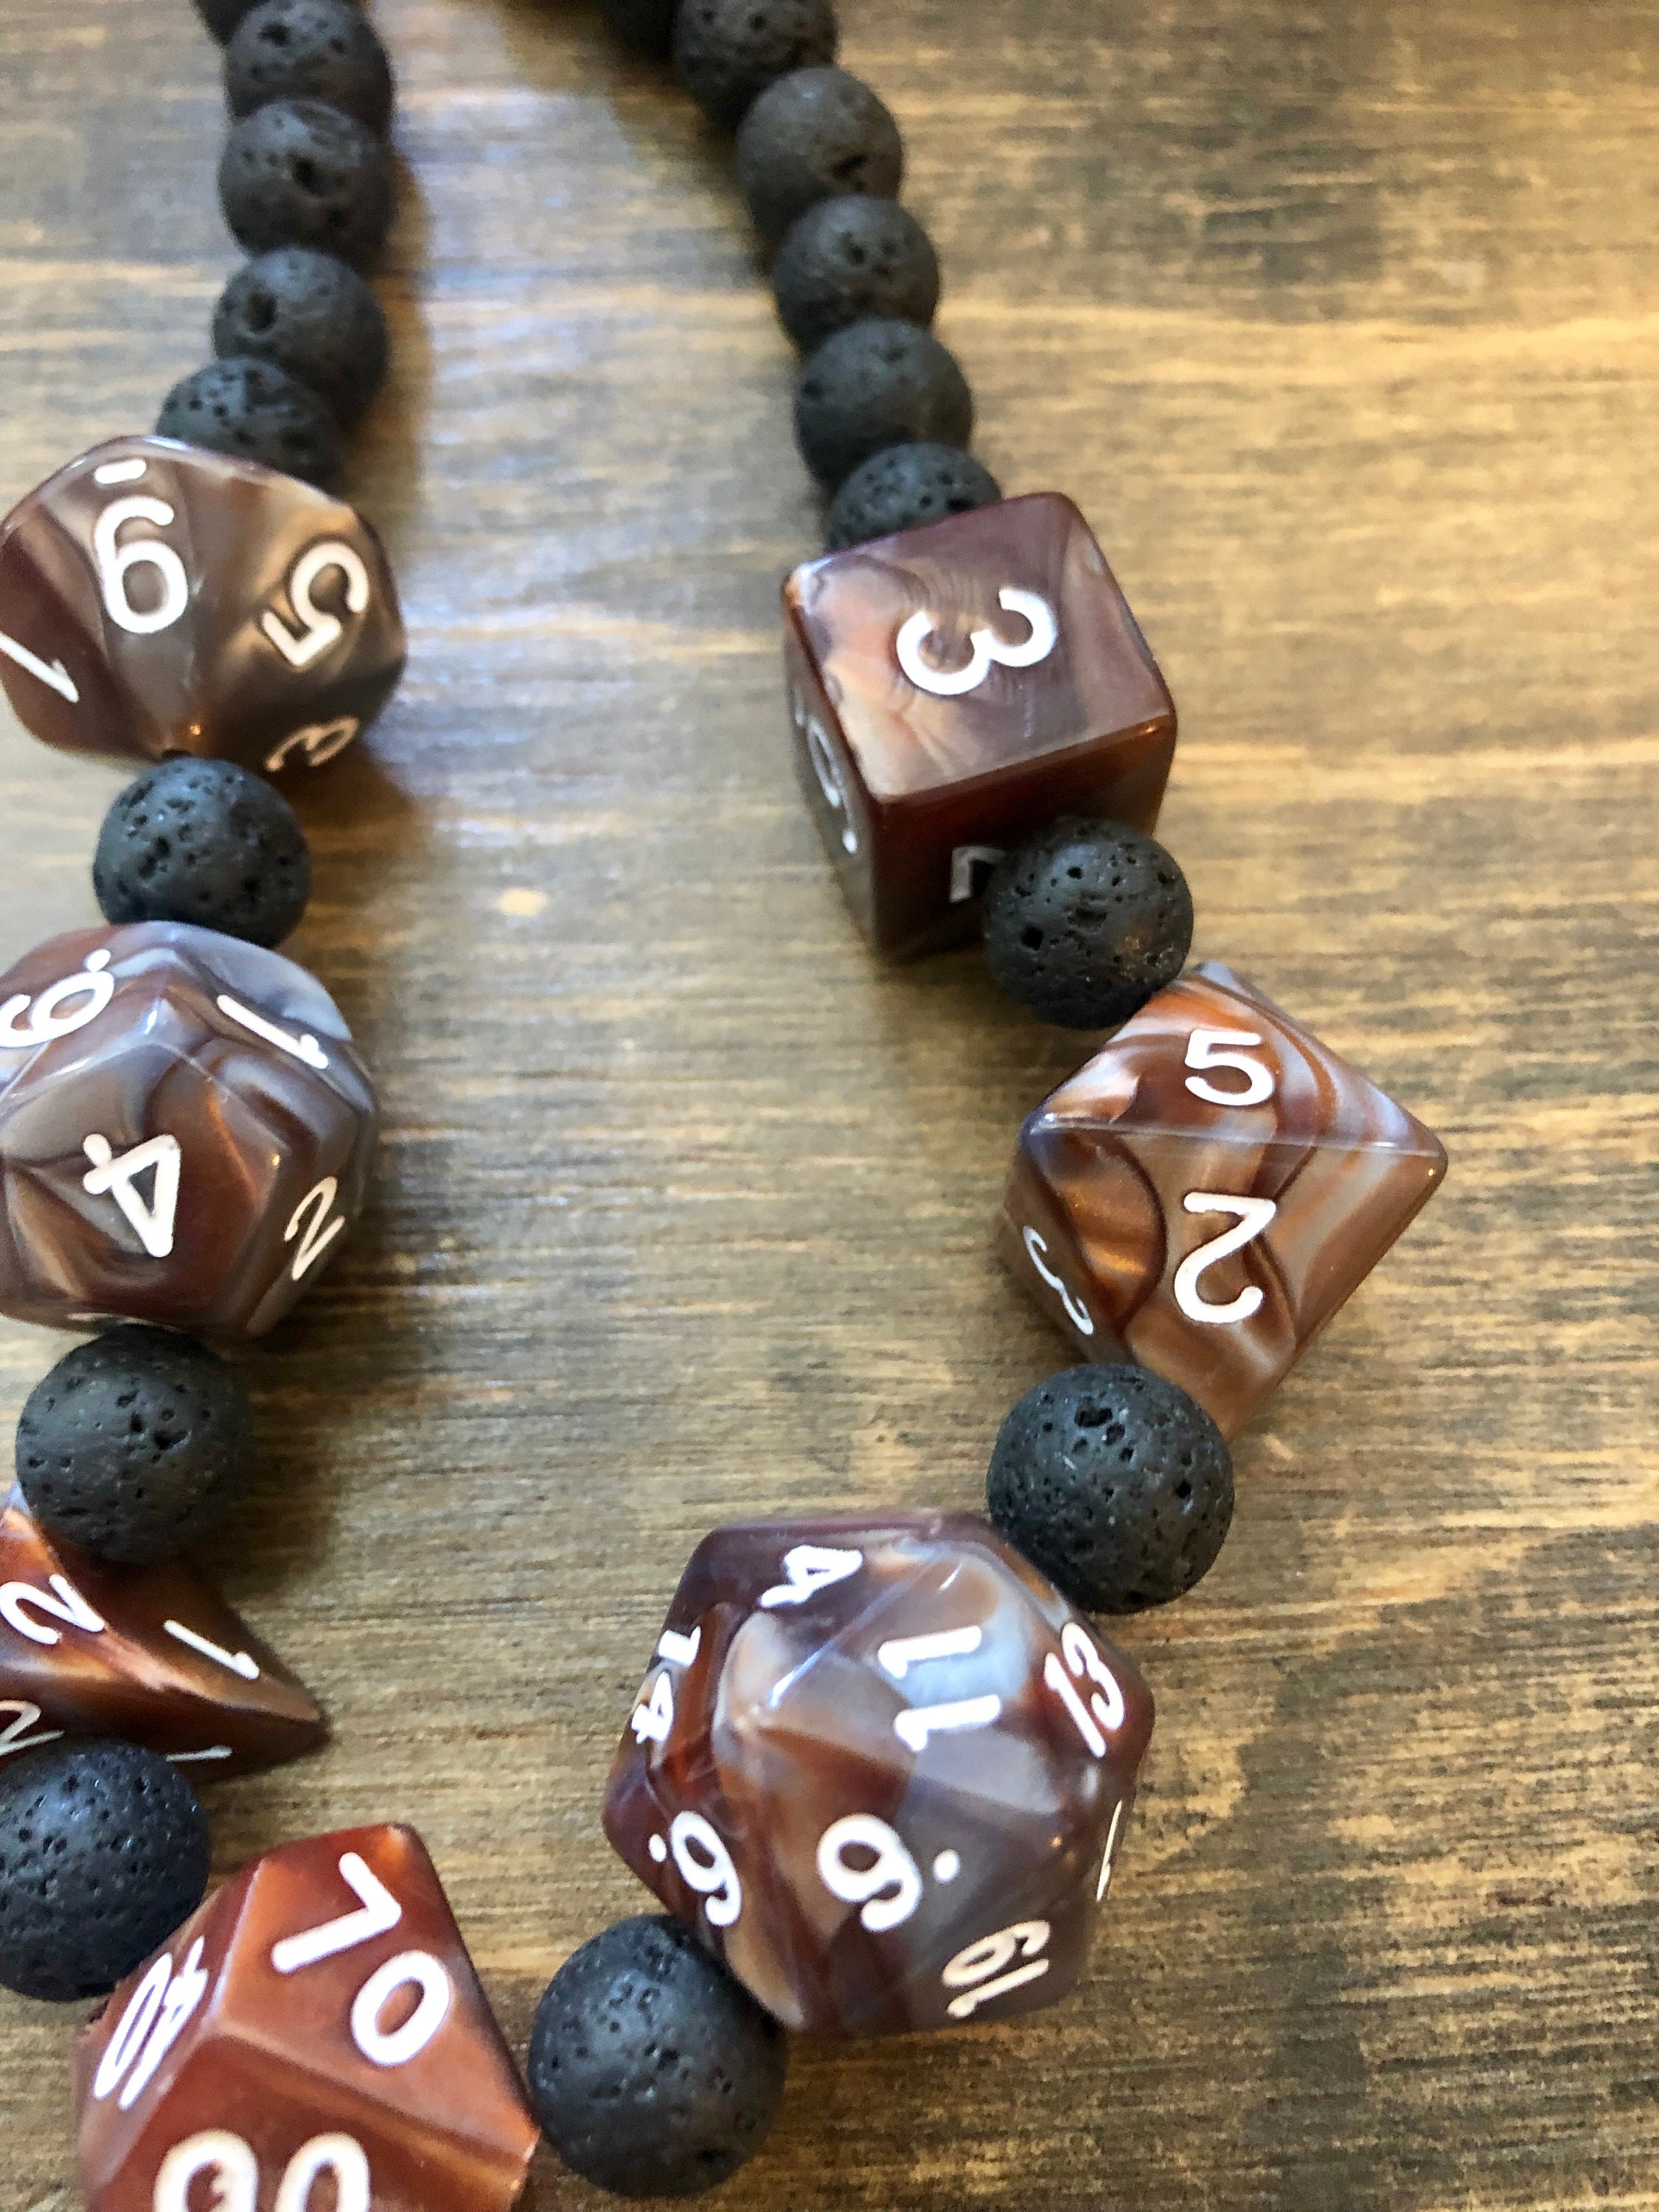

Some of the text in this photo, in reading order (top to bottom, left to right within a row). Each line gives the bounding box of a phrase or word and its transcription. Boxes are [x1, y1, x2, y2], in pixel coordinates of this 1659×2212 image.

[262, 540, 369, 667] 5
[896, 588, 1058, 695] 3
[217, 994, 329, 1070] 1
[1184, 1029, 1274, 1106] 5
[83, 1133, 181, 1258] 4
[1174, 1192, 1277, 1324] 2
[0, 1573, 105, 1645] 2
[759, 1545, 863, 1608] 4
[163, 1619, 260, 1680] 1
[877, 1625, 1002, 1752] 11
[1043, 1621, 1127, 1758] 13
[271, 1851, 452, 2067] 70
